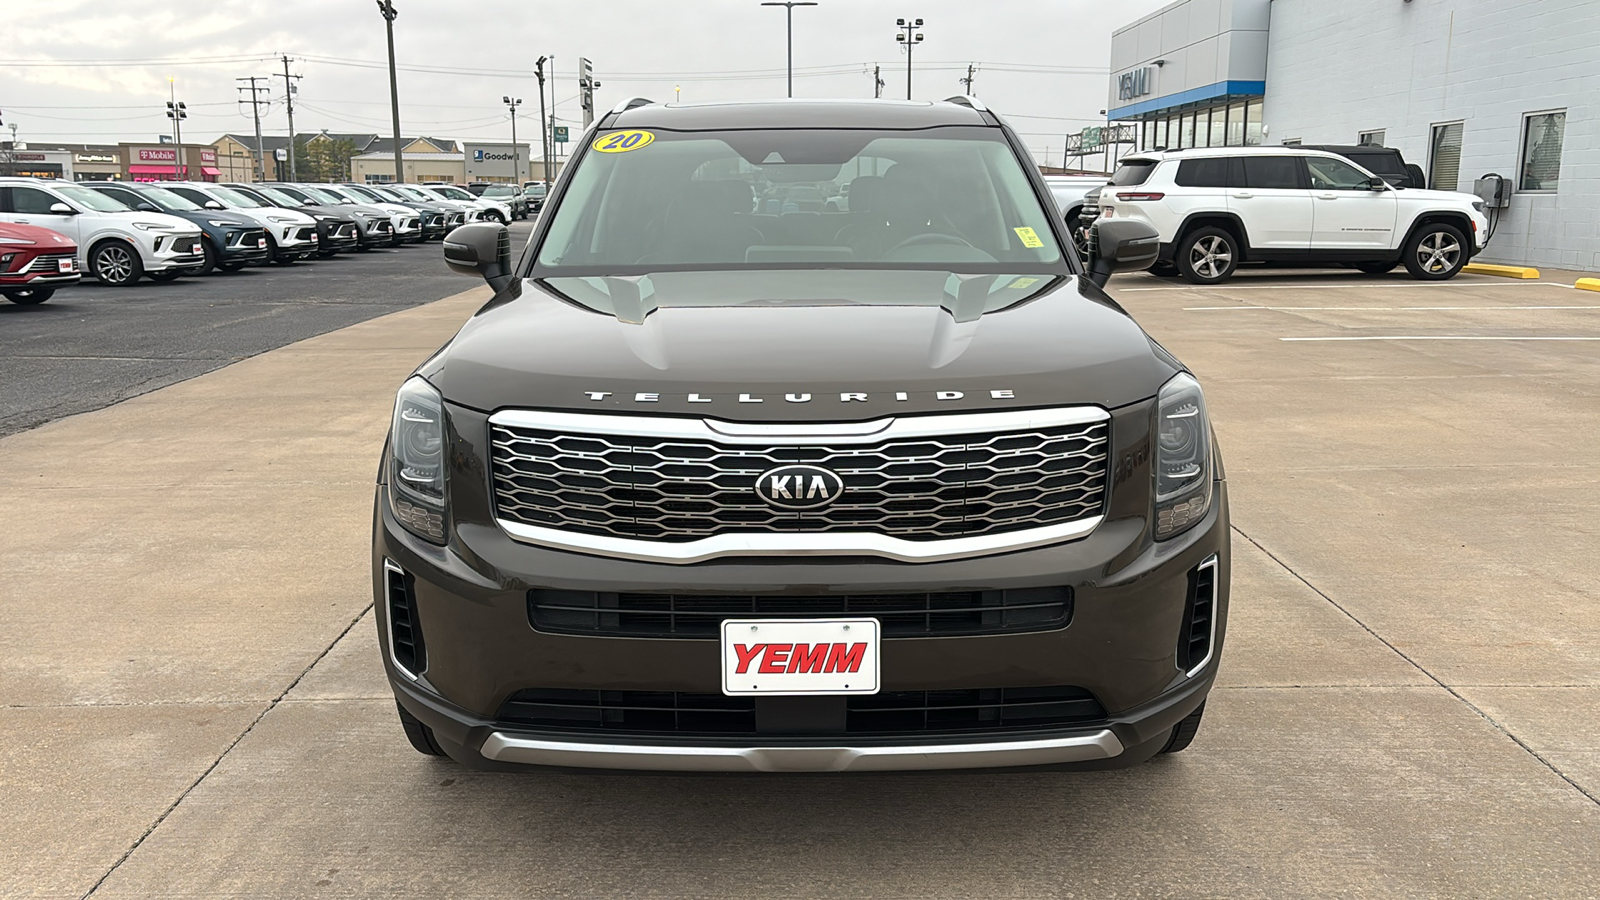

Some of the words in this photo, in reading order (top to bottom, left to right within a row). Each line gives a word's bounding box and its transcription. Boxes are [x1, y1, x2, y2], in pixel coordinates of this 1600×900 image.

[602, 133, 643, 150] 20
[149, 151, 175, 160] Mobile
[584, 389, 1016, 404] TELLURIDE
[770, 475, 829, 499] KIA
[733, 642, 868, 674] YEMM
